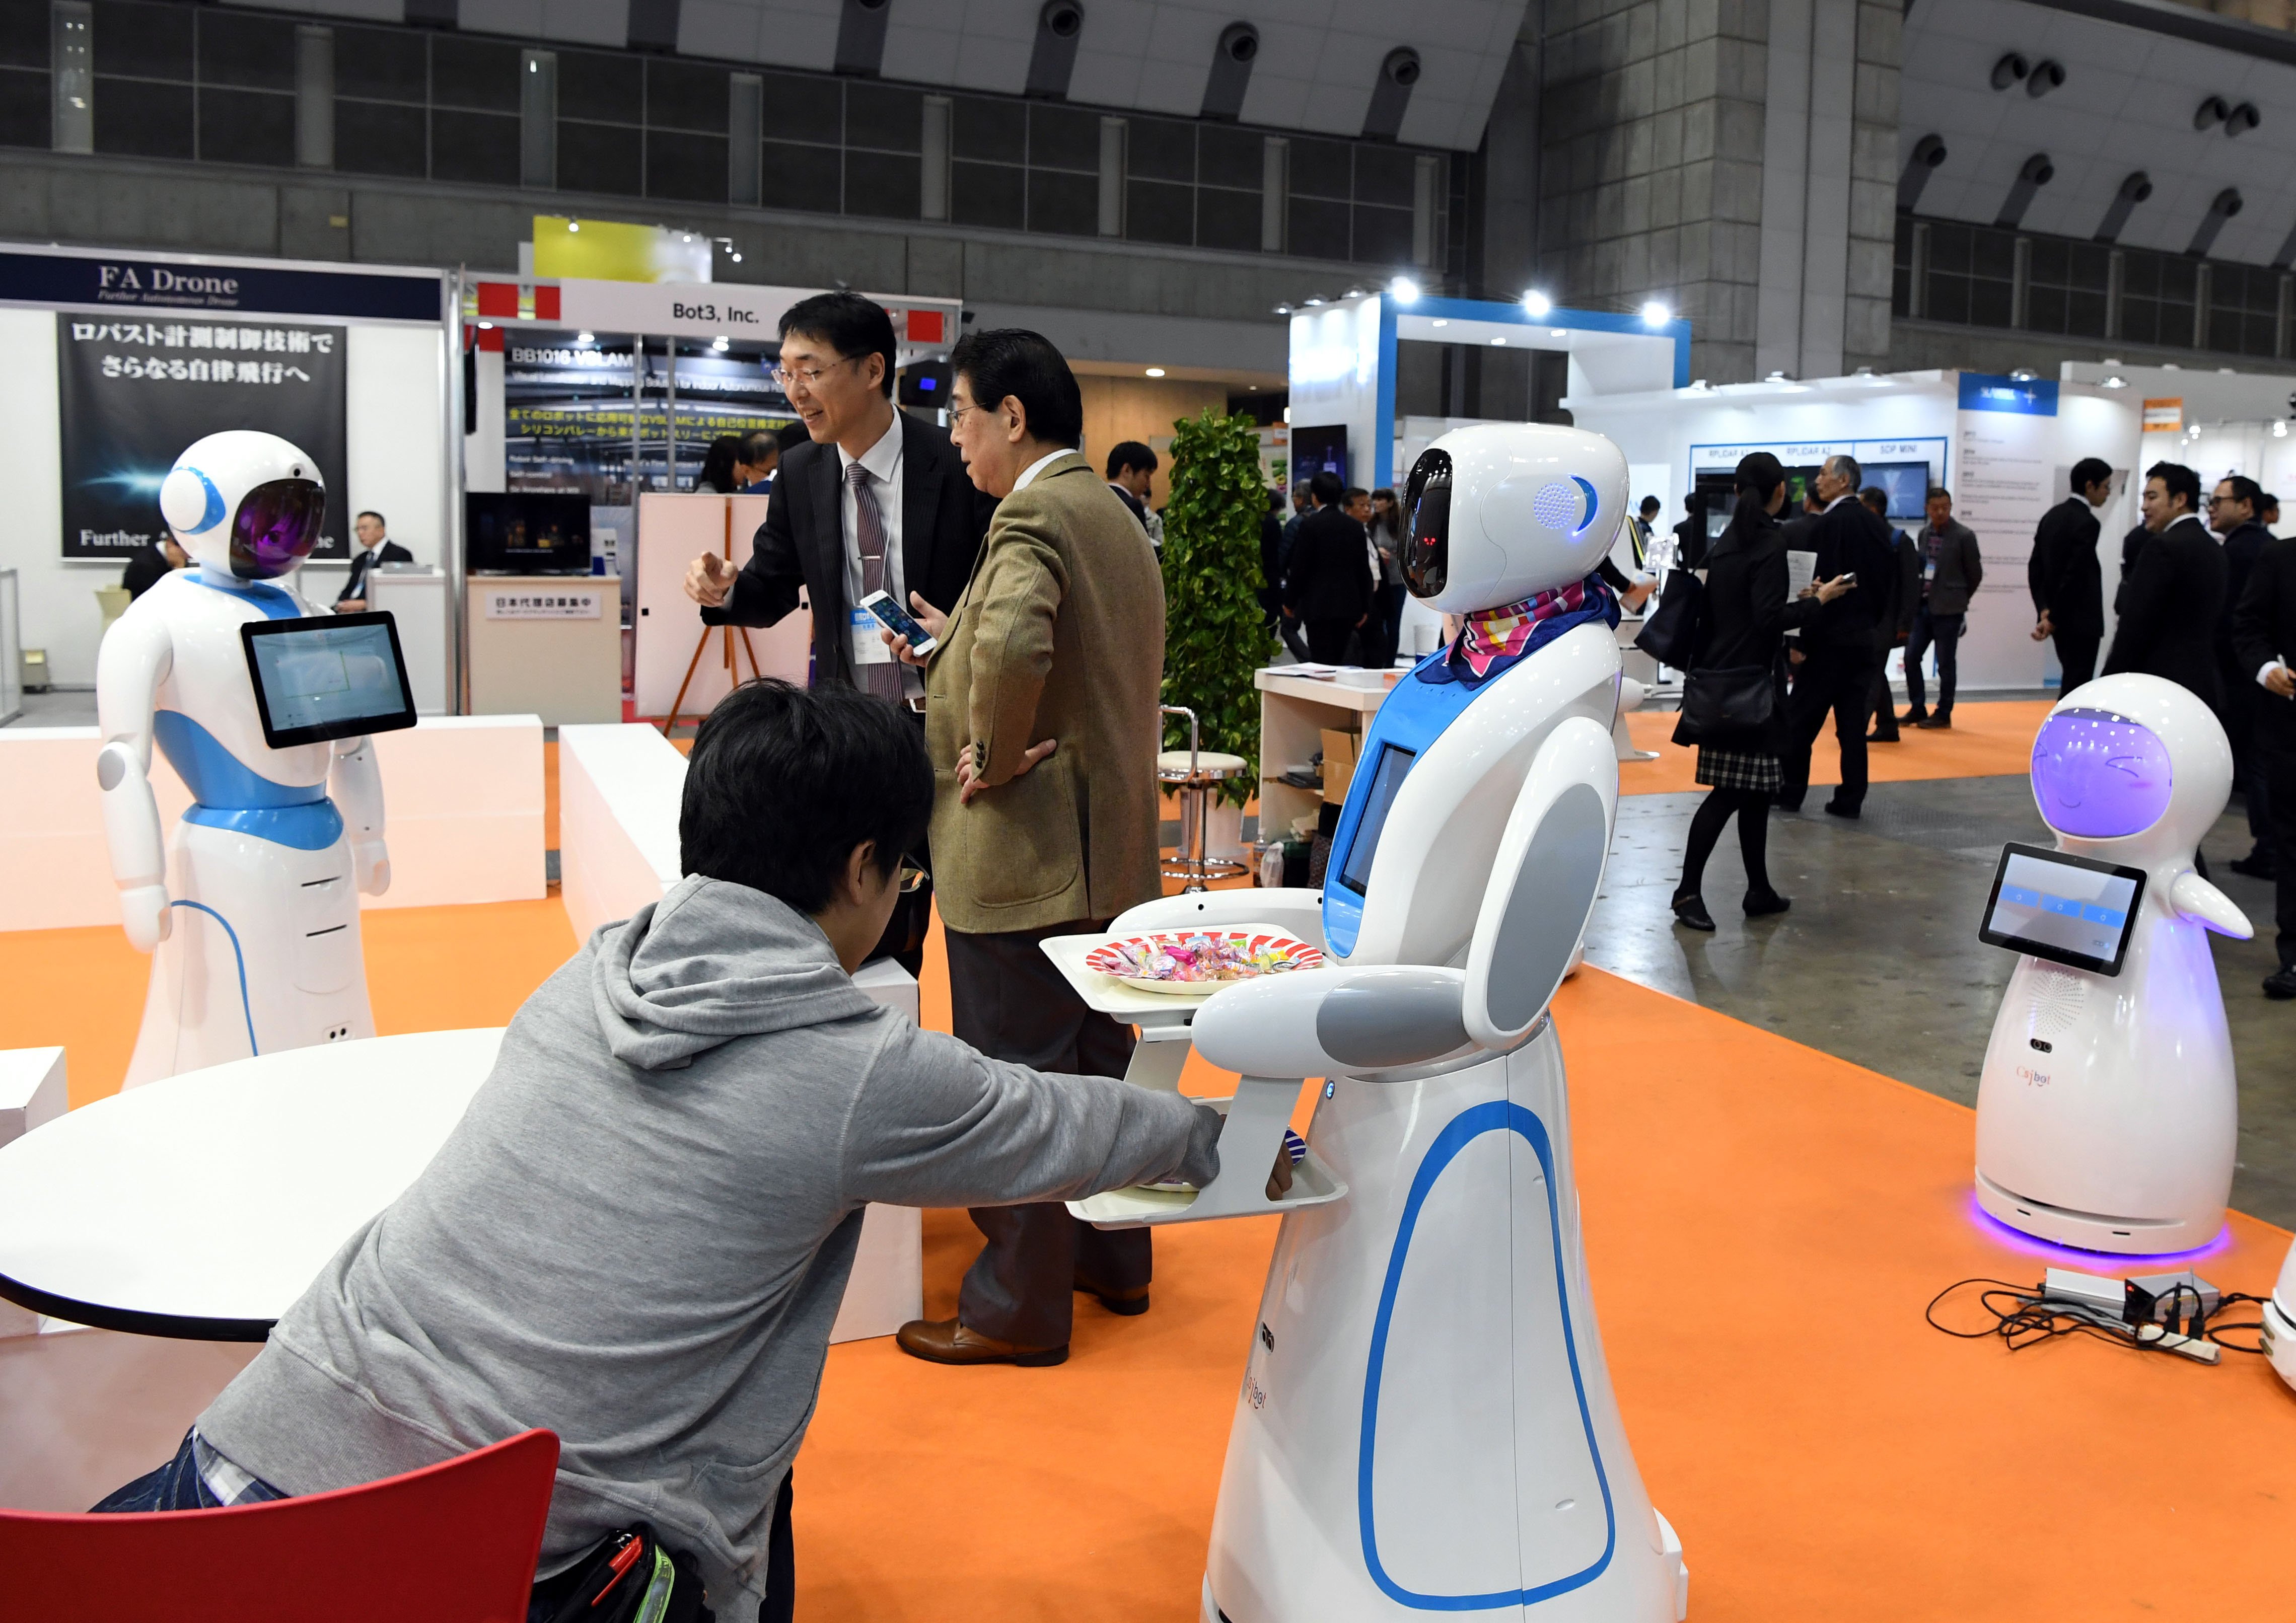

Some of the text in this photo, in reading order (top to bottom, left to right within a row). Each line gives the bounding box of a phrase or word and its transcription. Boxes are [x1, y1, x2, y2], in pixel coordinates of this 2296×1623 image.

[98, 265, 239, 294] FA Drone
[673, 303, 759, 323] Bot3, Inc.
[72, 323, 334, 353] ロバスト計測制御技術で
[102, 354, 311, 384] さらなる自律飛行へ
[512, 347, 571, 365] BB1016
